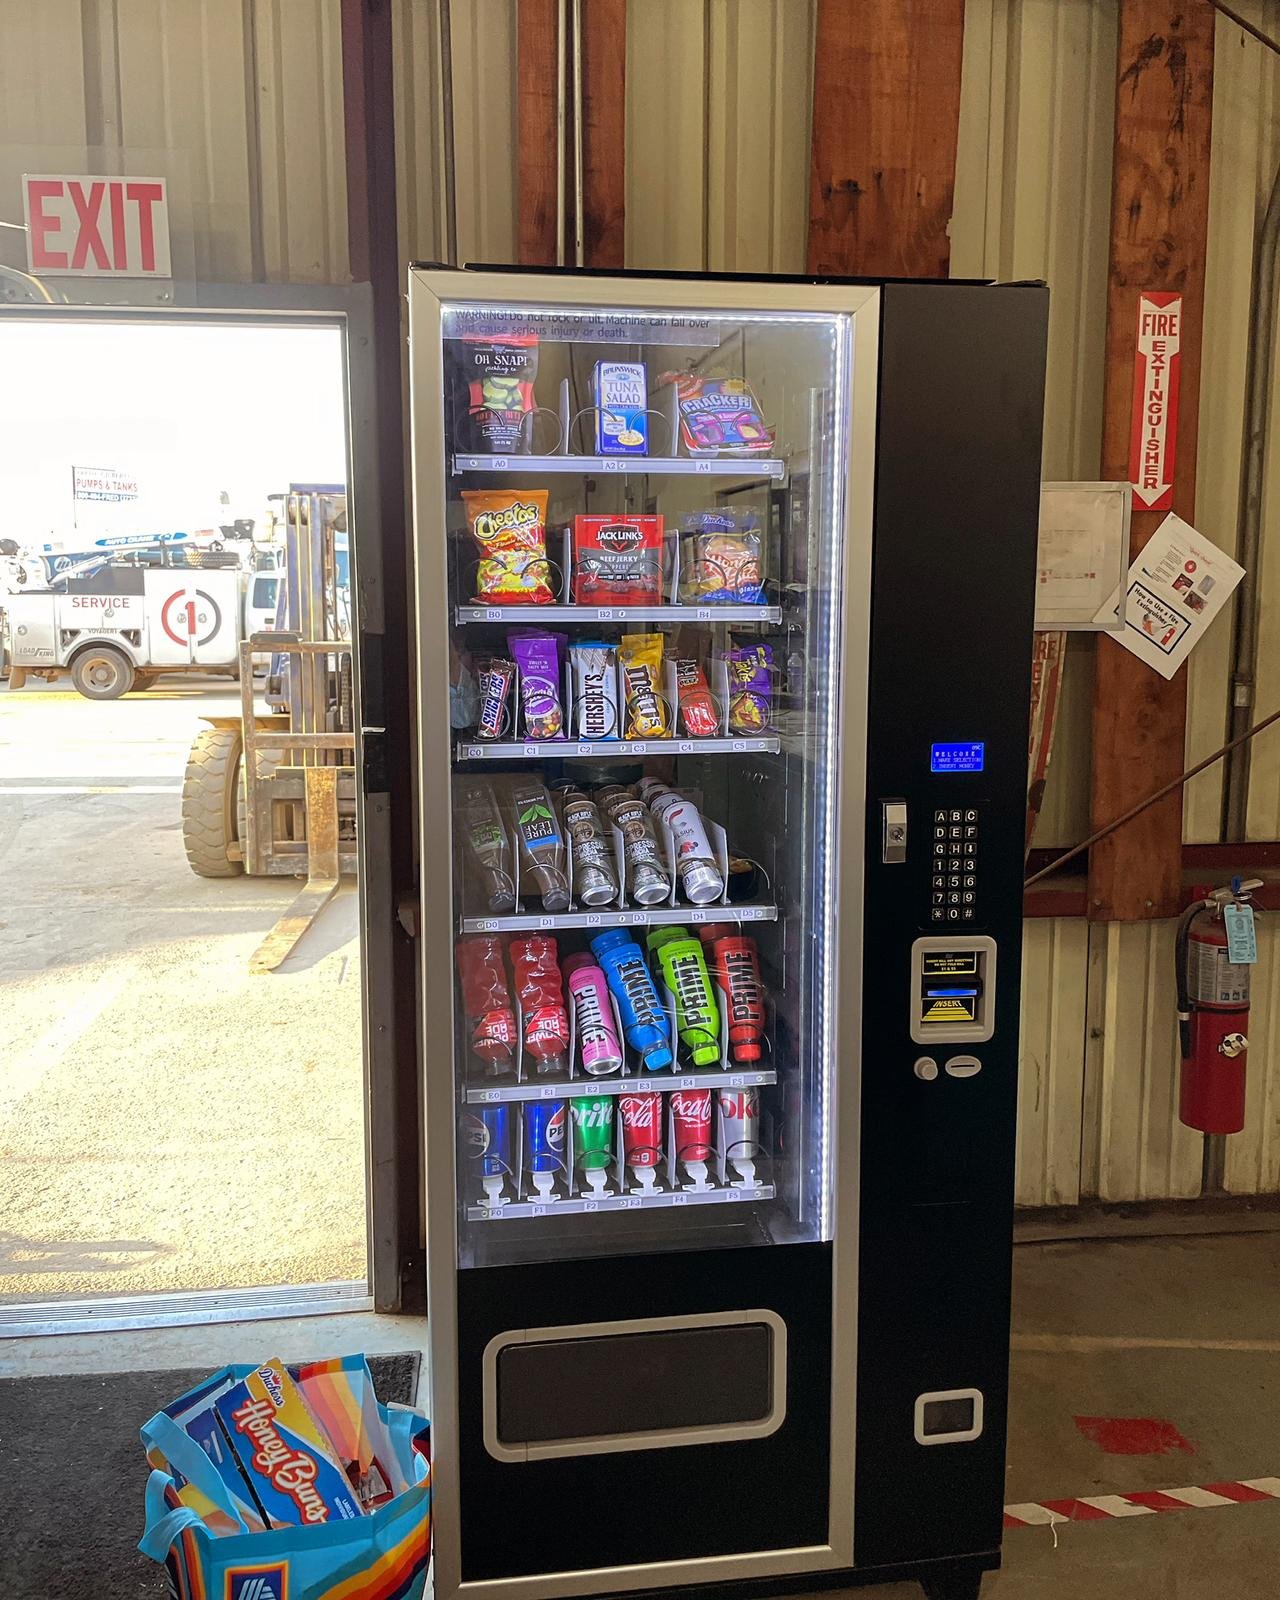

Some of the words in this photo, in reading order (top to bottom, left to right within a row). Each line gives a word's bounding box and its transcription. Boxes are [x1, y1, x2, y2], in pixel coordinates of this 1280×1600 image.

[28, 180, 163, 271] EXIT
[528, 312, 544, 322] not
[574, 315, 584, 323] or
[606, 315, 646, 326] Machine
[649, 317, 667, 327] can
[671, 317, 685, 328] fall
[689, 319, 710, 329] over
[1142, 313, 1178, 337] FIRE
[480, 325, 508, 334] cause
[511, 325, 547, 335] serious
[551, 326, 580, 338] injury
[583, 328, 594, 337] or
[598, 327, 628, 338] death.
[475, 354, 490, 366] OH
[494, 354, 528, 367] SNAP!
[609, 383, 639, 394] TUNA
[606, 392, 641, 404] SALAD
[682, 395, 751, 412] CRACKER
[1143, 340, 1169, 490] EXTINGUISHER
[604, 462, 616, 470] A2
[698, 463, 709, 471] A4
[77, 478, 103, 490] PUMPS
[113, 481, 138, 492] TANKS
[475, 502, 537, 538] Cheetos
[596, 531, 617, 541] JACK
[72, 597, 130, 609] SERVICE
[1134, 587, 1147, 599] How
[1147, 597, 1153, 605] to
[1154, 601, 1165, 613] Use
[1169, 613, 1179, 625] Fire
[1136, 599, 1168, 625] Extinguisher
[185, 601, 196, 635] 1
[584, 674, 605, 734] HERSHEY'S
[526, 747, 537, 755] C1
[633, 745, 645, 753] C3
[681, 744, 692, 752] C4
[734, 742, 745, 750] C5
[469, 749, 482, 757] C0
[937, 812, 945, 821] A
[952, 811, 961, 821] B
[967, 811, 976, 821] C
[526, 828, 553, 840] PURE
[675, 828, 695, 841] ELSIUS
[936, 828, 945, 838] D
[952, 828, 960, 837] E
[967, 827, 975, 837] F
[936, 844, 944, 854] G
[952, 844, 960, 854] H
[937, 861, 942, 870] 1
[952, 861, 959, 870] 2
[966, 861, 974, 870] 3
[935, 878, 943, 887] 4
[951, 877, 959, 887] 5
[966, 877, 974, 886] 6
[936, 894, 944, 903] 7
[951, 893, 959, 903] 8
[965, 893, 973, 902] 9
[634, 913, 645, 922] D3
[693, 912, 704, 920] D4
[950, 909, 958, 919] 0
[965, 909, 973, 918] #
[485, 921, 498, 929] D0
[542, 918, 553, 926] D1
[671, 954, 712, 1027] PRIME
[725, 951, 761, 1023] PRIME
[933, 1000, 962, 1008] INSERT
[683, 1079, 694, 1087] E4
[732, 1077, 743, 1085] E5
[491, 1209, 502, 1217] F0
[258, 1367, 284, 1407] Duchess
[235, 1399, 286, 1475] Honey
[275, 1452, 326, 1523] Buns
